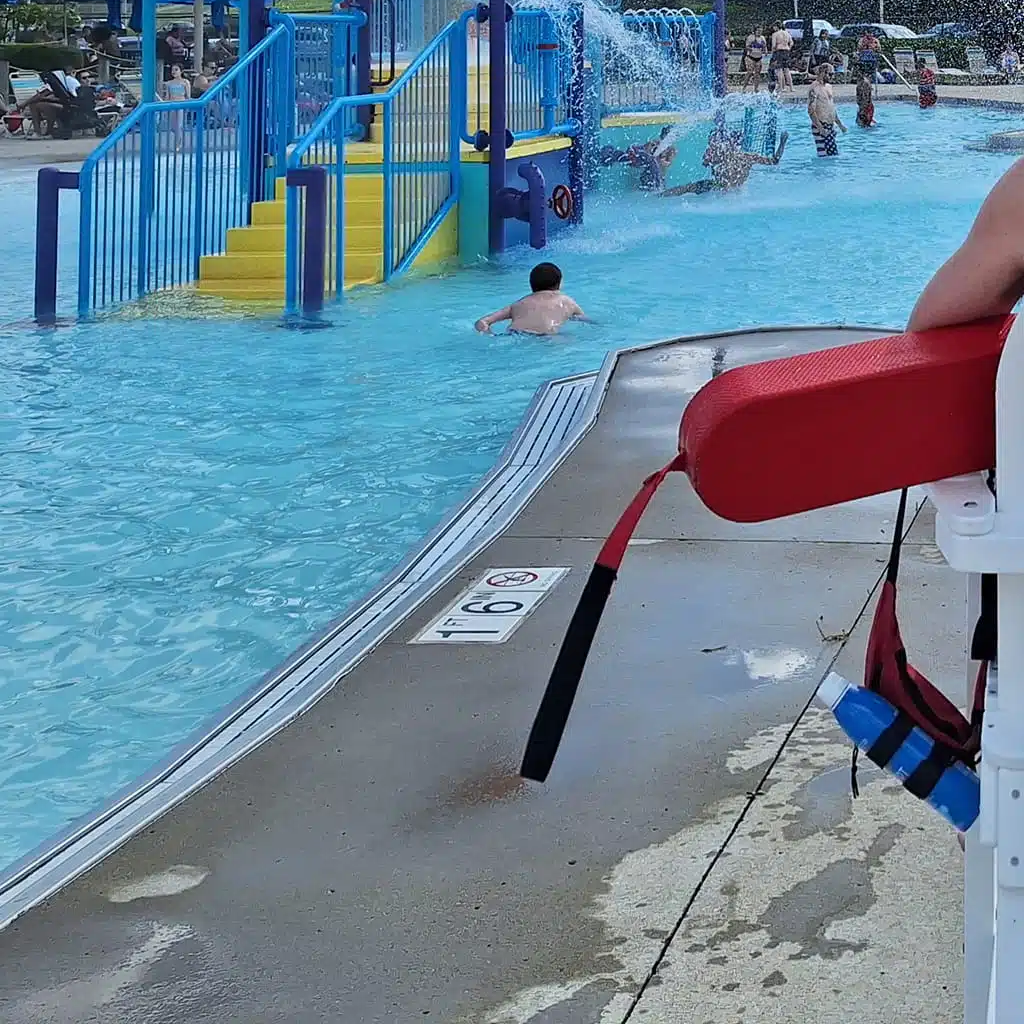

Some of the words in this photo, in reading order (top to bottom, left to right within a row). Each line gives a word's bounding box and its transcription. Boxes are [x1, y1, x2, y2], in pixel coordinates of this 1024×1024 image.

[461, 601, 524, 613] 6
[442, 618, 469, 626] FT
[436, 630, 500, 638] 1
